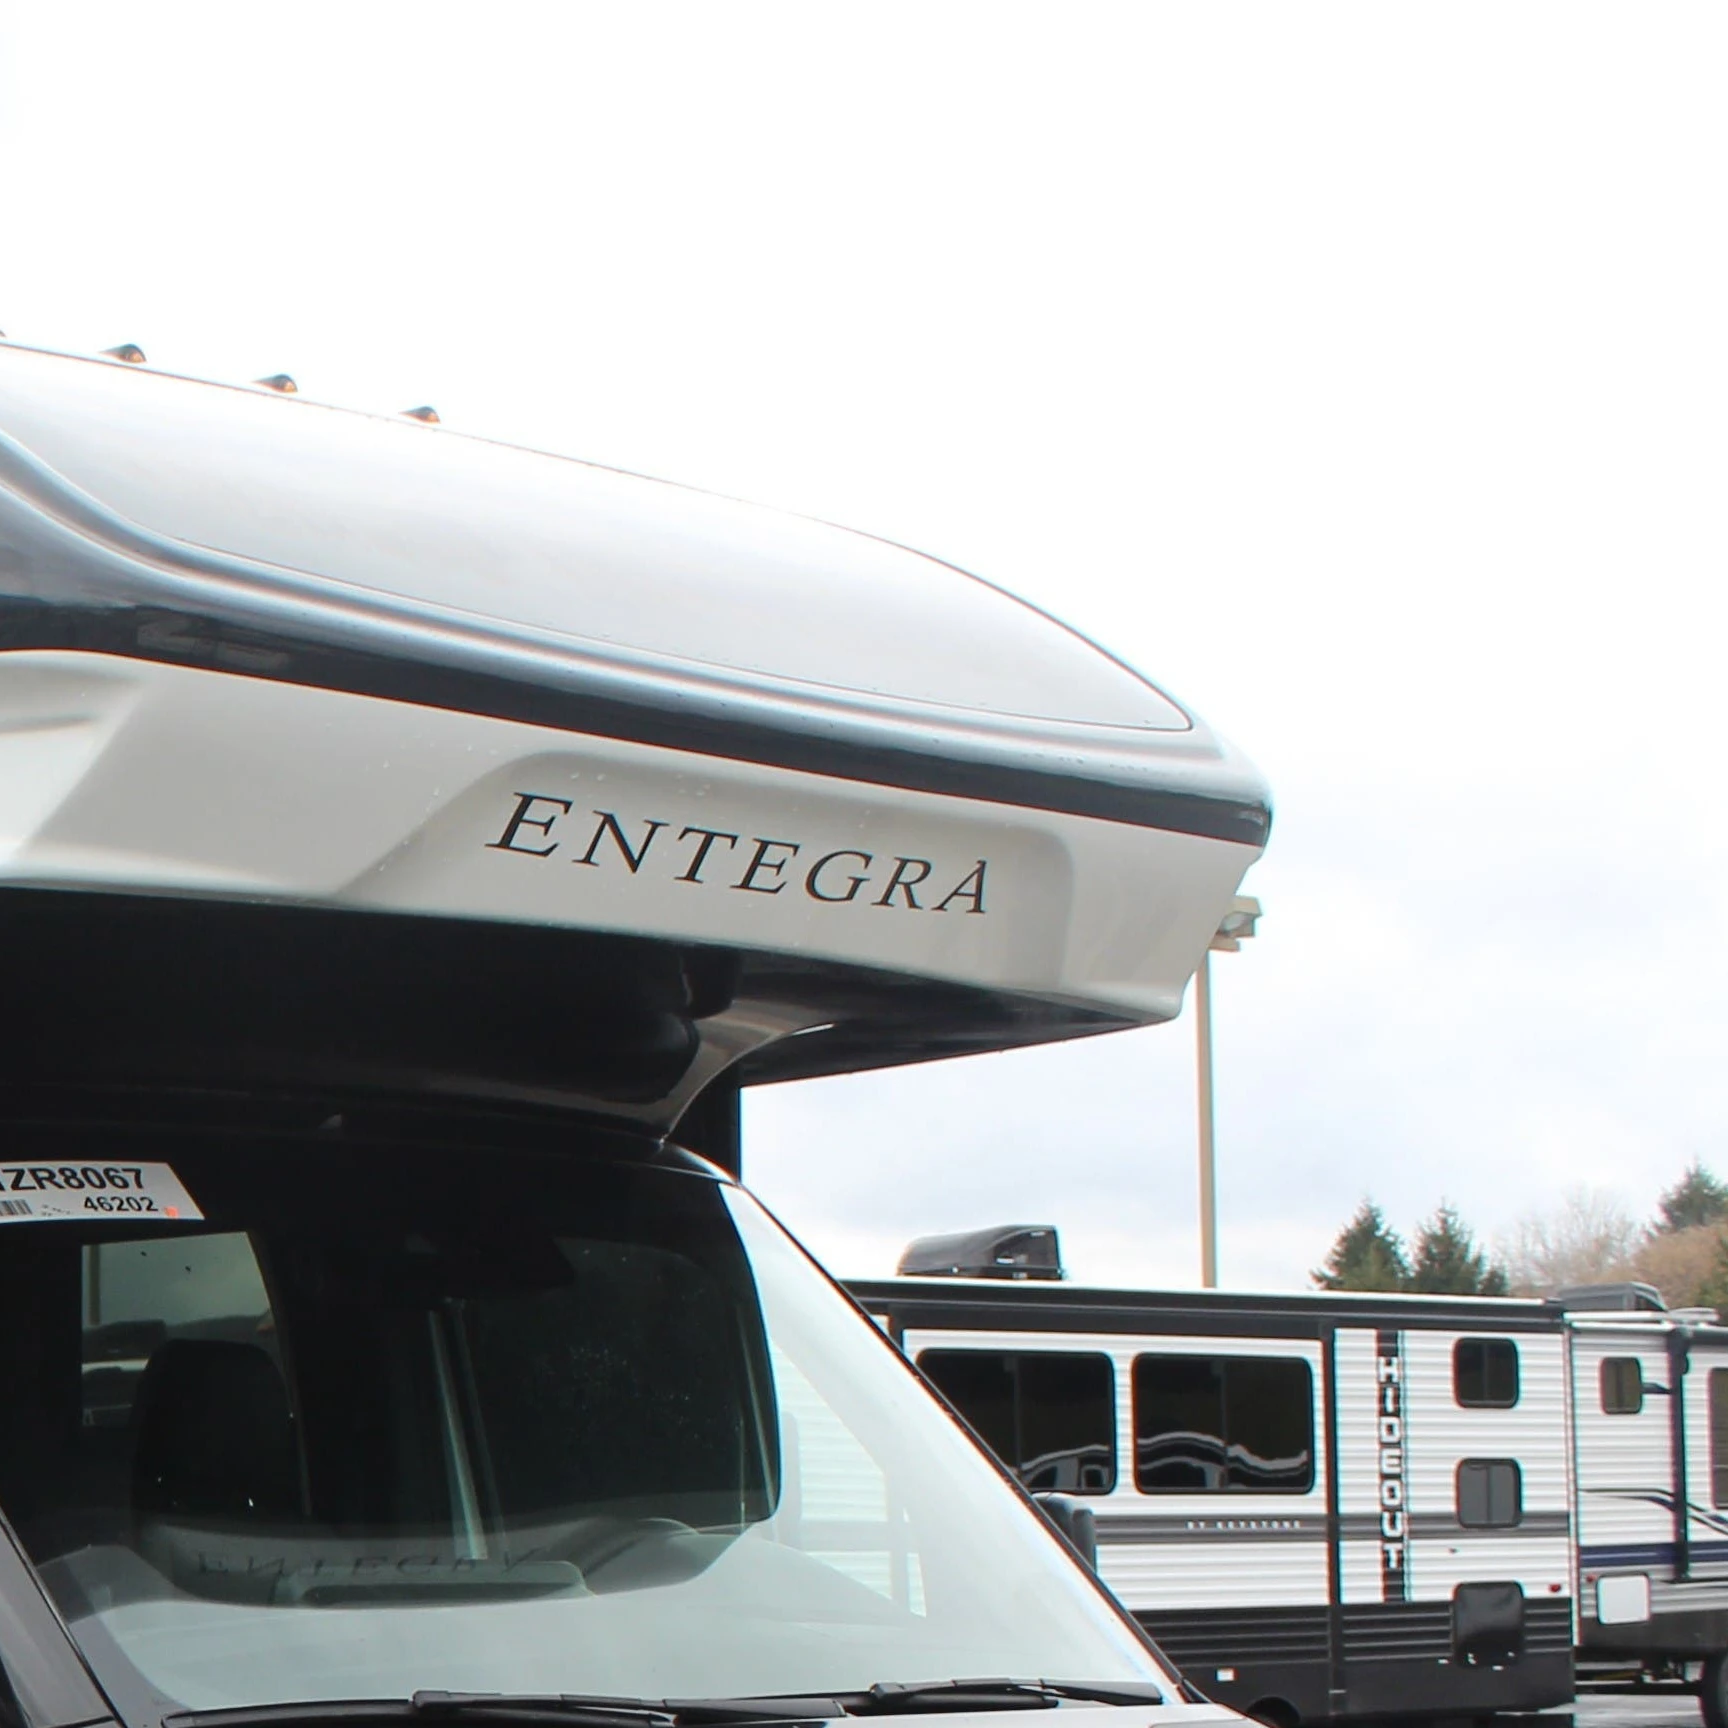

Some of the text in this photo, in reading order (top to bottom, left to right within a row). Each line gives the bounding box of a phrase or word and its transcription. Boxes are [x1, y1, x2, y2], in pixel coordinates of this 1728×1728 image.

[483, 791, 988, 915] ENTEGRA
[83, 1195, 159, 1213] 46202
[1378, 1356, 1403, 1569] HIDEOUT
